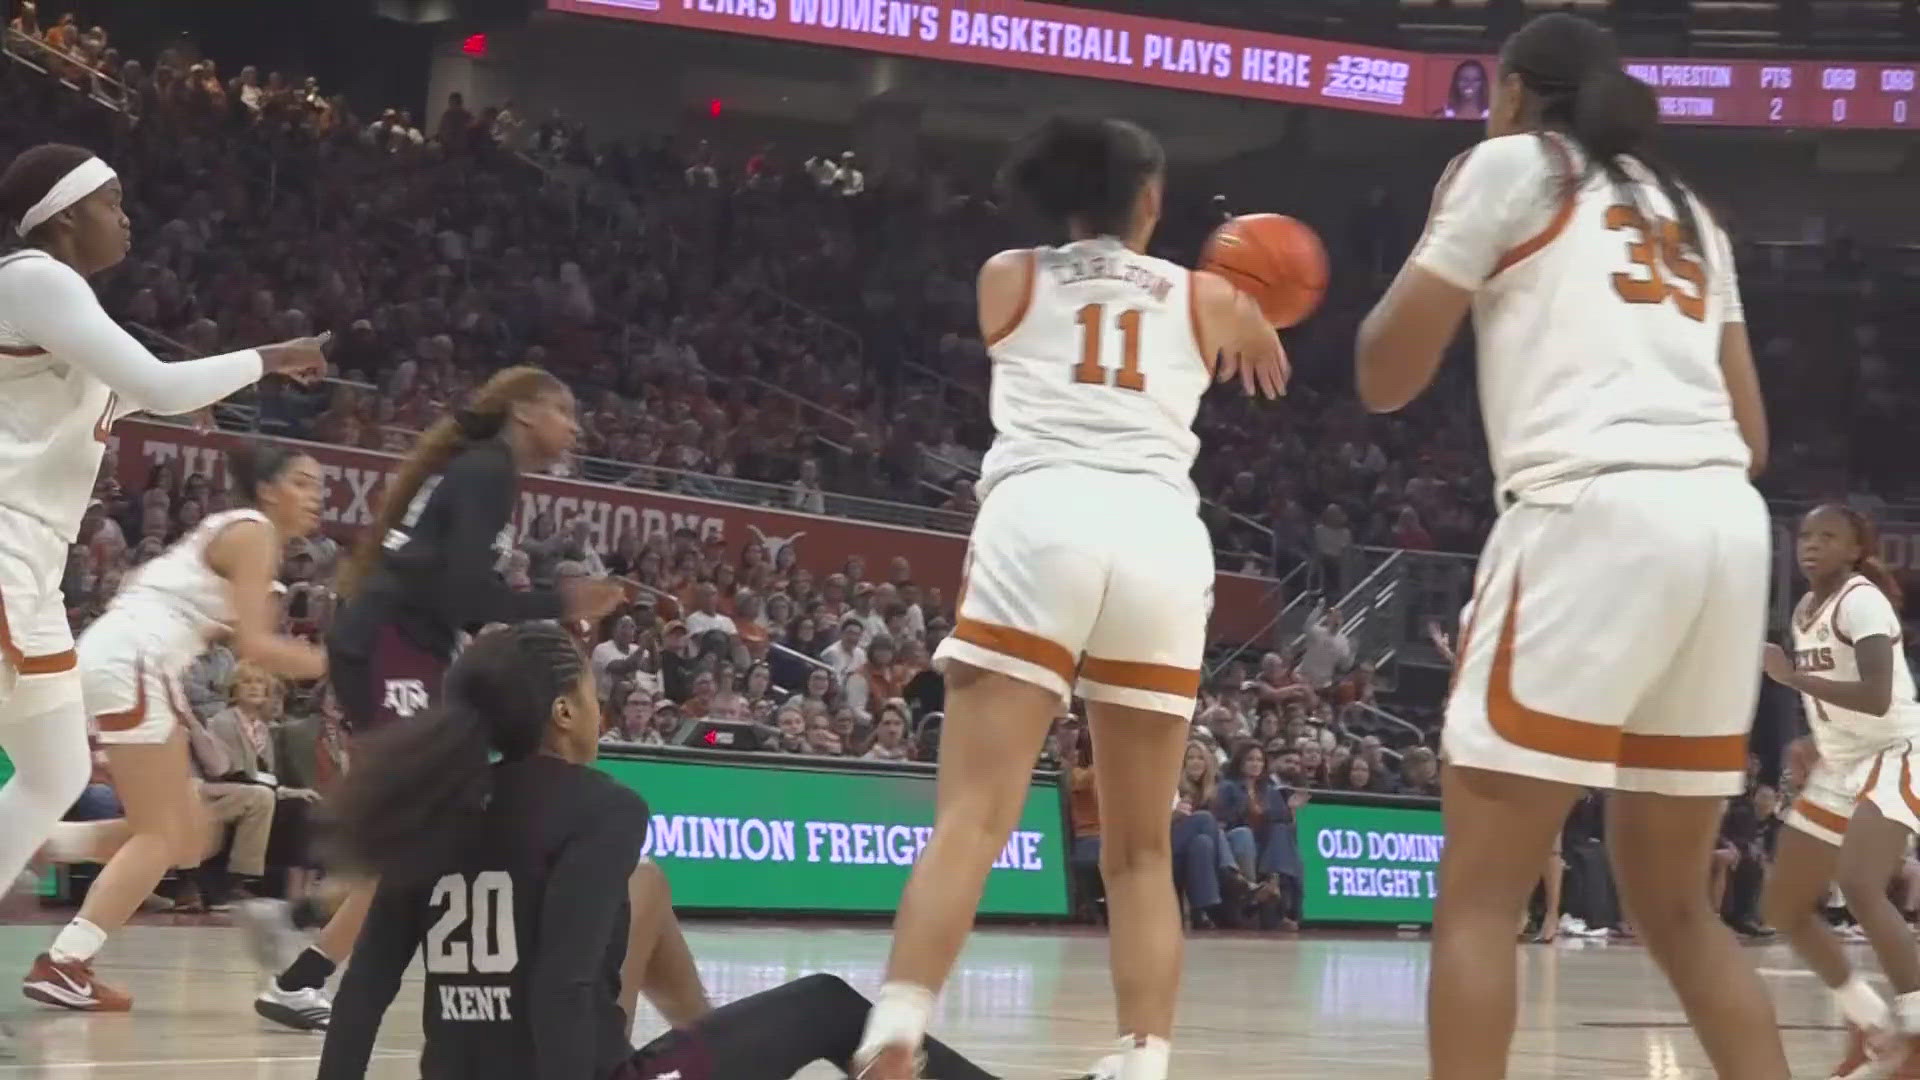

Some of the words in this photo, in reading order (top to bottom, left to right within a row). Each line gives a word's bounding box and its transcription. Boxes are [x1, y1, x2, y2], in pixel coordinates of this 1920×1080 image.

[789, 0, 938, 41] WOMEN'S
[950, 9, 1132, 65] BASKETBALL
[1144, 33, 1232, 79] PLAYS
[1242, 47, 1311, 88] HERE
[1328, 72, 1407, 97] ZONE
[1761, 66, 1793, 89] PTS
[1769, 97, 1783, 121] 2
[1832, 98, 1847, 122] 0
[1893, 99, 1906, 123] 0
[1070, 303, 1146, 392] 11
[640, 814, 797, 862] MINION
[804, 822, 934, 866] FREIG
[992, 831, 1044, 870] NE
[1317, 828, 1364, 859] OLD
[1366, 831, 1444, 862] DOMIN
[1327, 865, 1421, 898] FREIGHT
[426, 870, 519, 974] 20
[438, 984, 513, 1022] KENT
